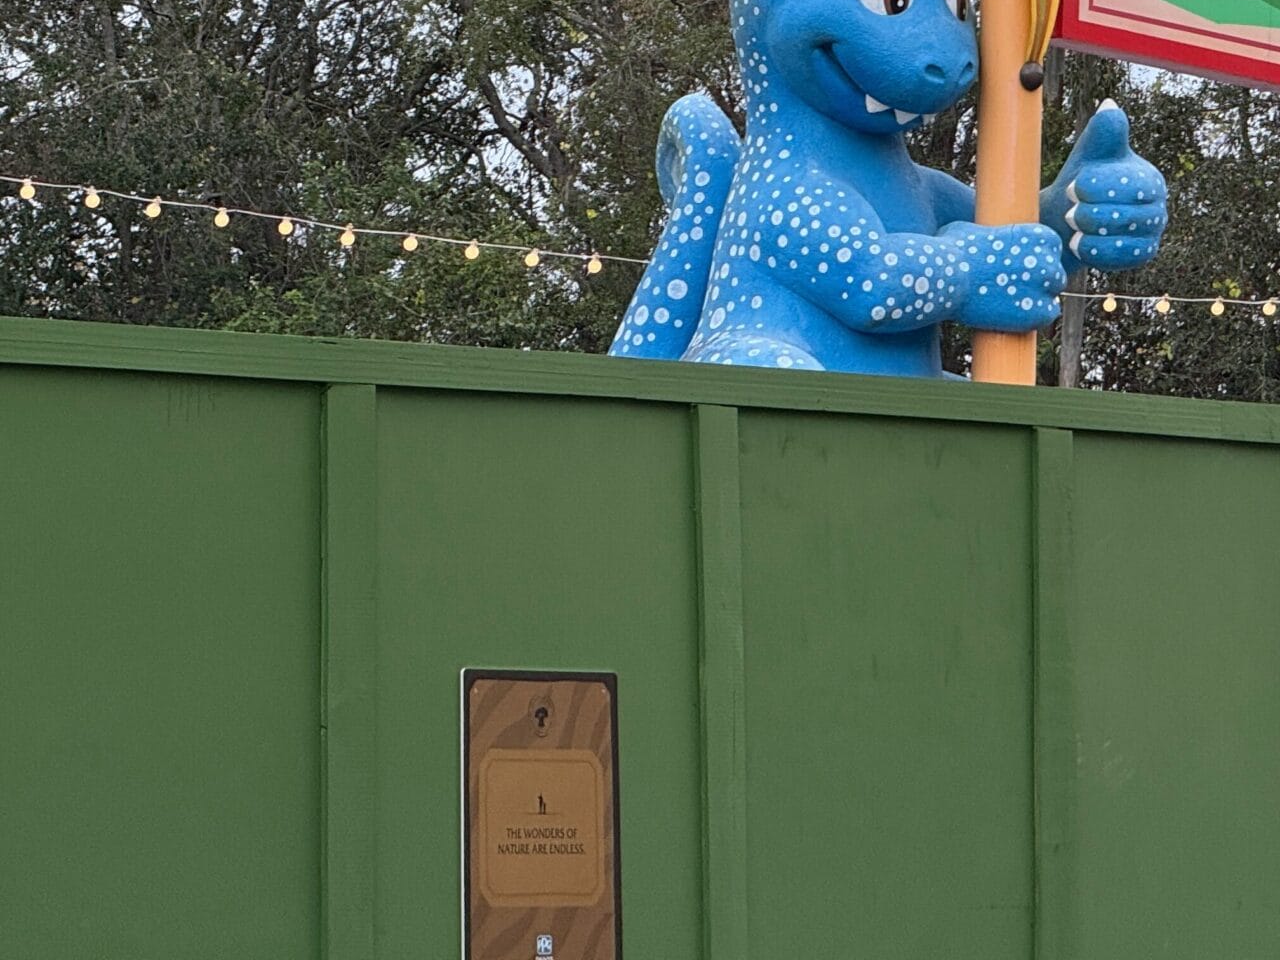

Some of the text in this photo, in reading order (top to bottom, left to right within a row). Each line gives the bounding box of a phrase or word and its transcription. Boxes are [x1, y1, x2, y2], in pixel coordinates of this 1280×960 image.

[506, 827, 578, 839] THE WONDERS OF
[497, 843, 530, 855] NATURE
[532, 843, 548, 855] ARE
